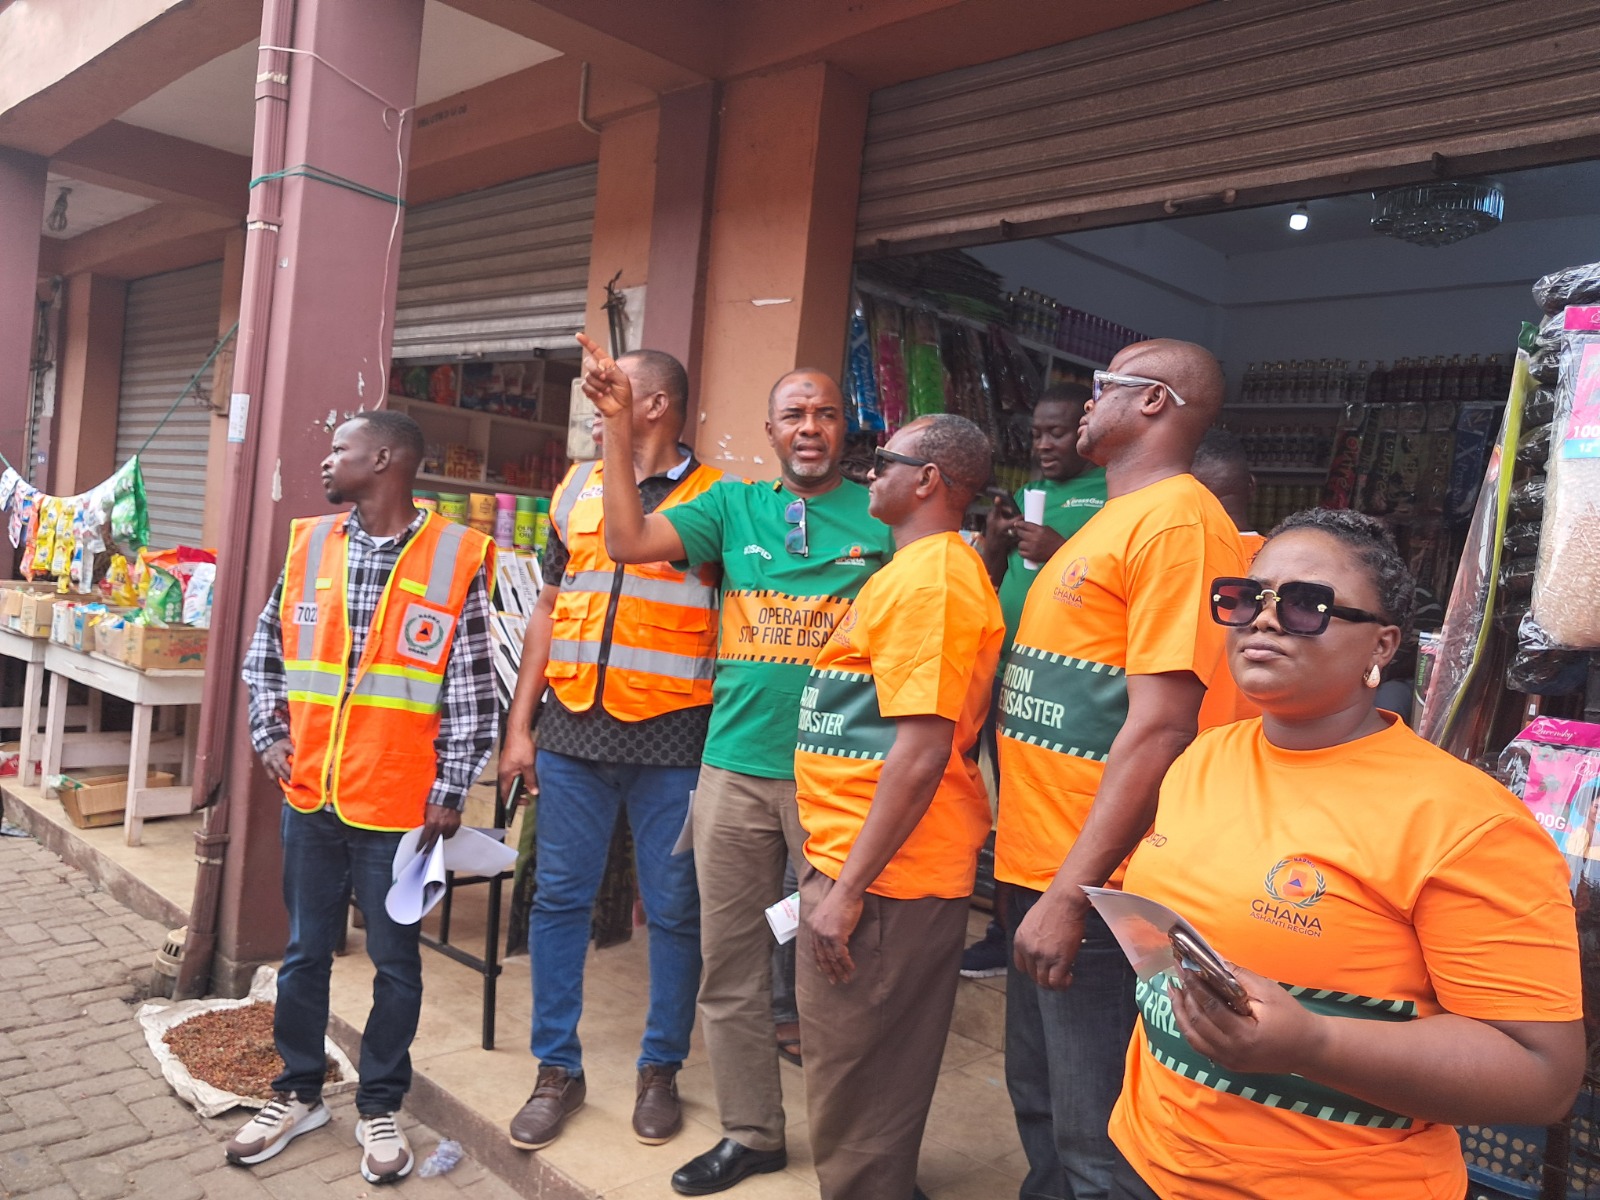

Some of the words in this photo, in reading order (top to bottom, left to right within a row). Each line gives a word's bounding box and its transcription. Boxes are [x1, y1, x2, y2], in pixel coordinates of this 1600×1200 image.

[1053, 586, 1083, 605] GHANA
[297, 606, 318, 622] 702
[758, 607, 834, 629] OPERATION
[762, 626, 793, 646] FIRE
[1416, 655, 1429, 687] Premium
[1249, 911, 1286, 928] ASHANTI
[1287, 924, 1321, 937] REGION
[1251, 899, 1322, 931] GHANA
